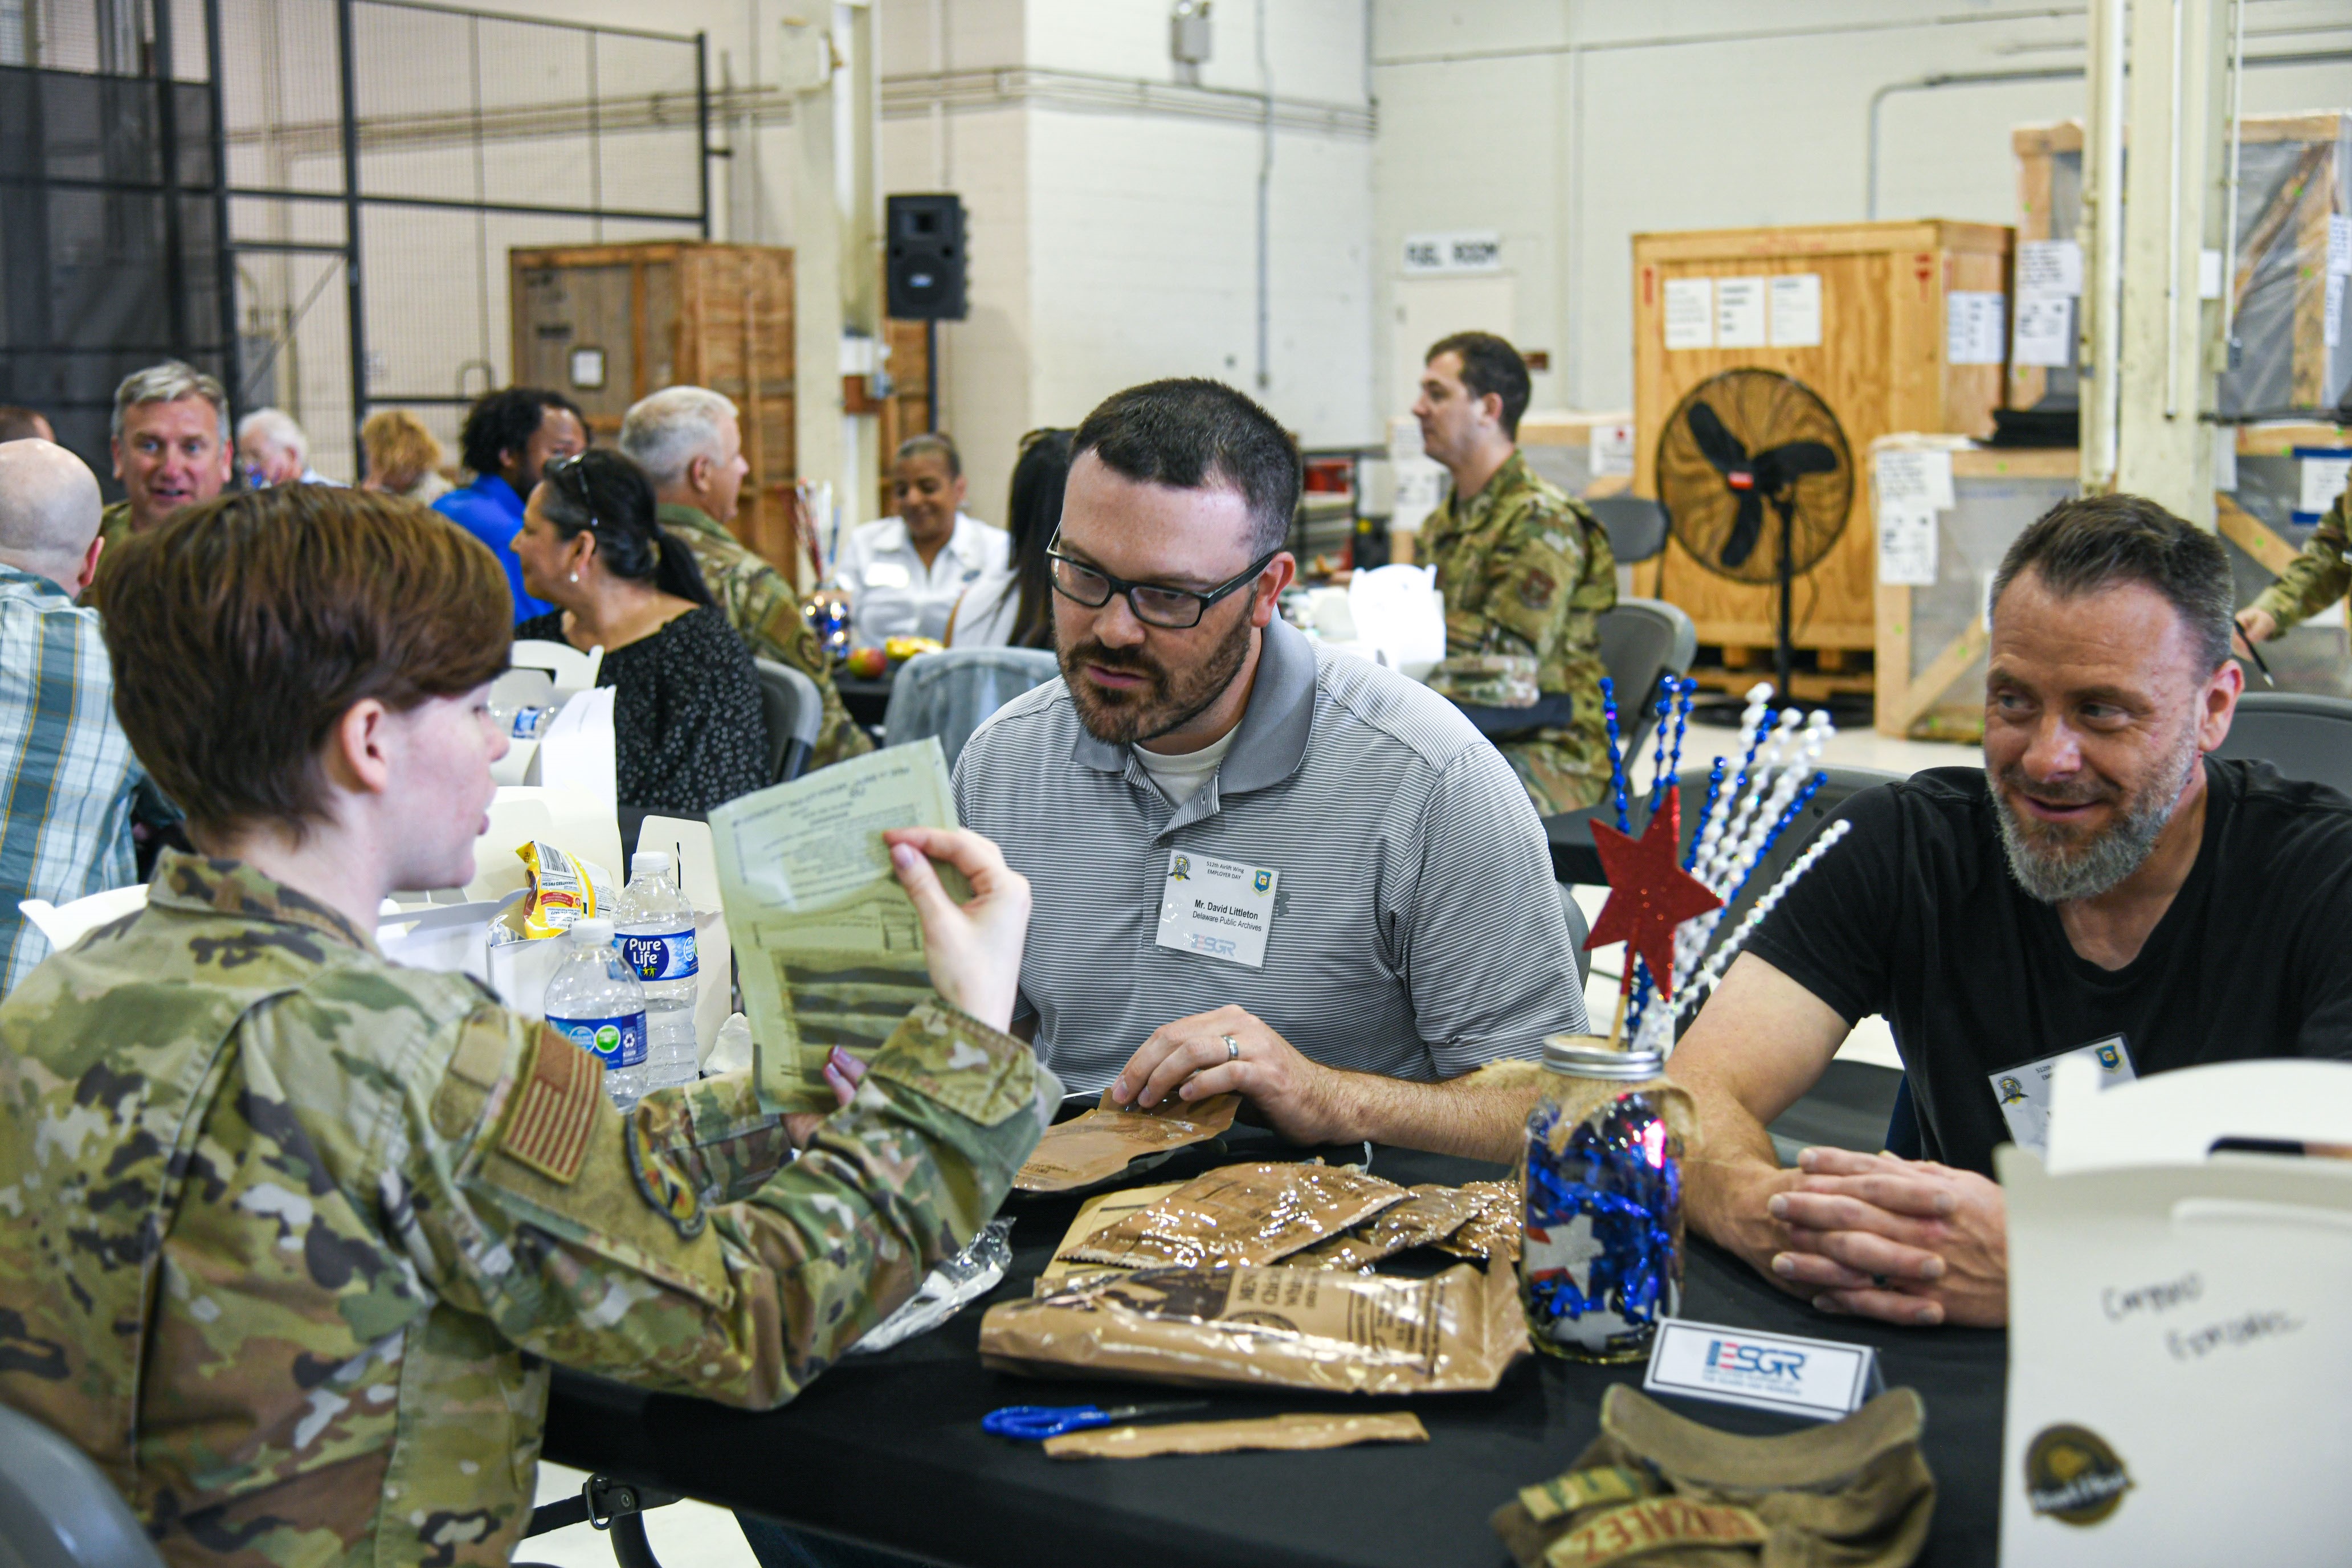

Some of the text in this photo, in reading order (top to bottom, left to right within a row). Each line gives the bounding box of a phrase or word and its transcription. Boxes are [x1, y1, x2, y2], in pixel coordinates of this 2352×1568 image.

[1207, 869, 1230, 879] EMPLOYER
[1195, 899, 1258, 920] Mr. David Littleton
[1193, 910, 1262, 932] Delaware Public Archives
[629, 938, 661, 951] Pure
[1191, 933, 1236, 957] ESGR
[633, 952, 658, 967] Life
[1706, 1340, 1806, 1381] ESGR
